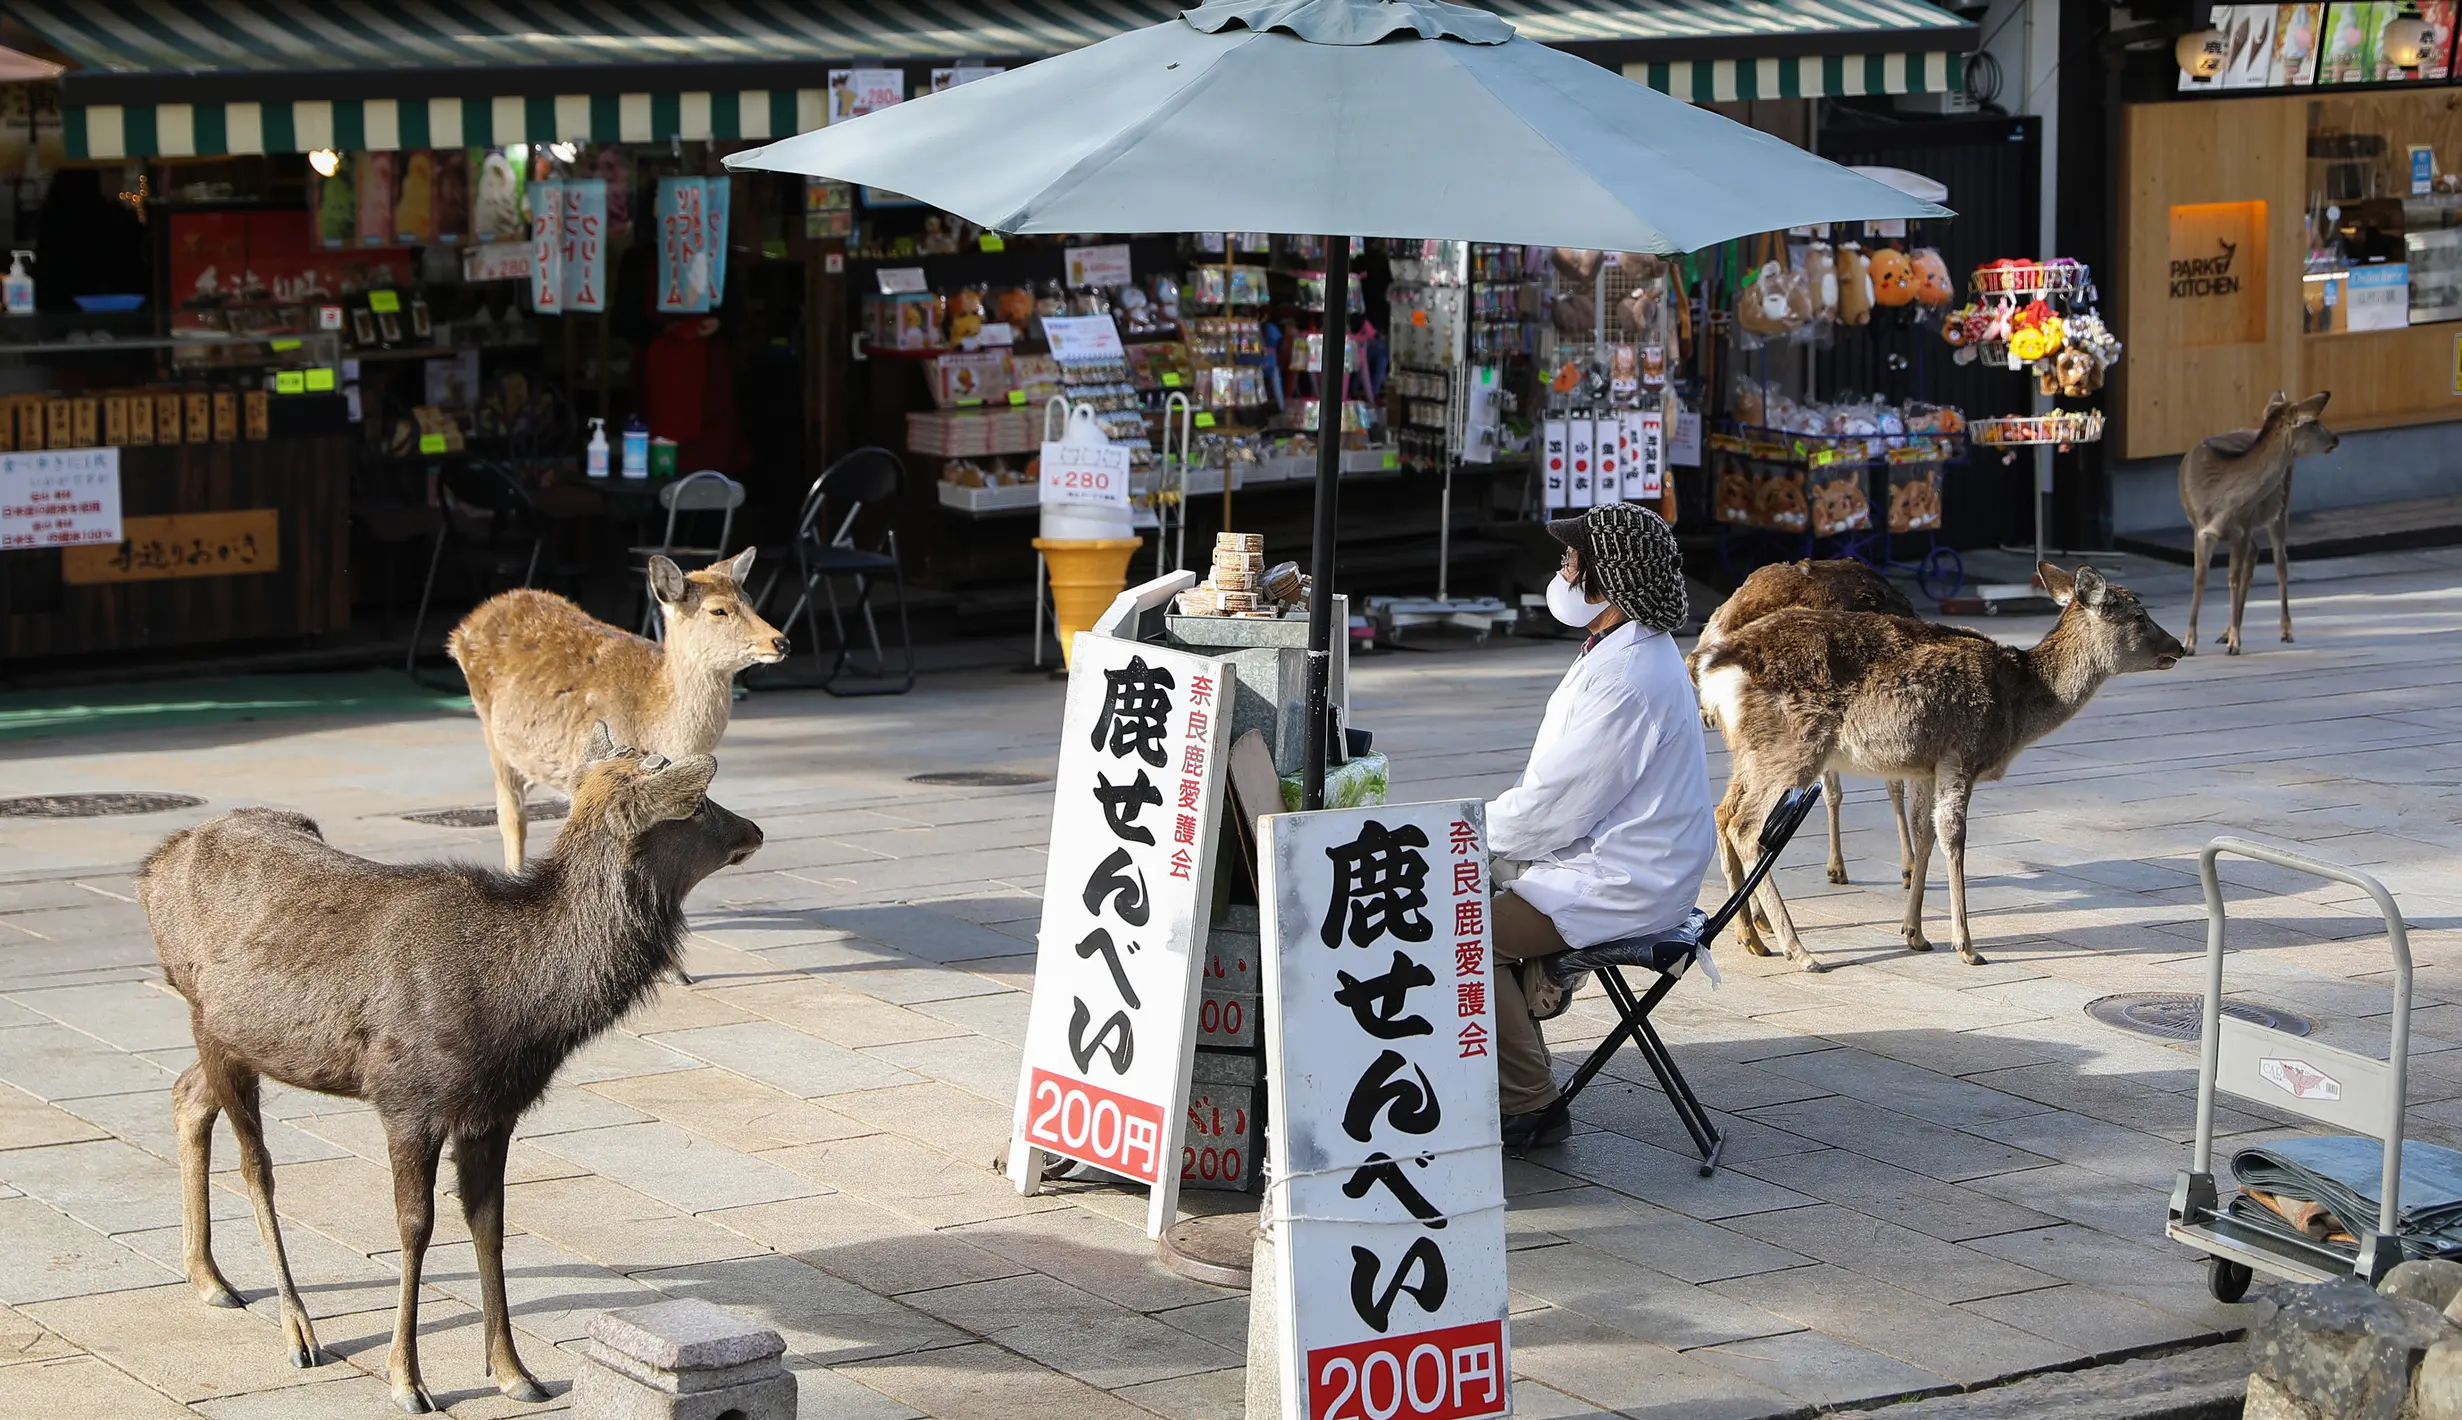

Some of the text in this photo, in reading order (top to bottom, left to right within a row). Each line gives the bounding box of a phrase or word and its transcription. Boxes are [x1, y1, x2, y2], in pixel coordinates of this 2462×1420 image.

[665, 215, 682, 304] クリーム
[2170, 258, 2214, 278] PARK
[2170, 276, 2239, 298] KITCHEN
[1169, 674, 1213, 882] 奈良鹿愛護会
[1069, 654, 1175, 1076] 鹿せんべい
[1449, 819, 1489, 1060] 奈良鹿愛護会
[1320, 819, 1449, 1334] 鹿せんべい
[1031, 1078, 1159, 1174] 200円
[1180, 1147, 1241, 1182] 200
[1320, 1340, 1499, 1420] 200円
